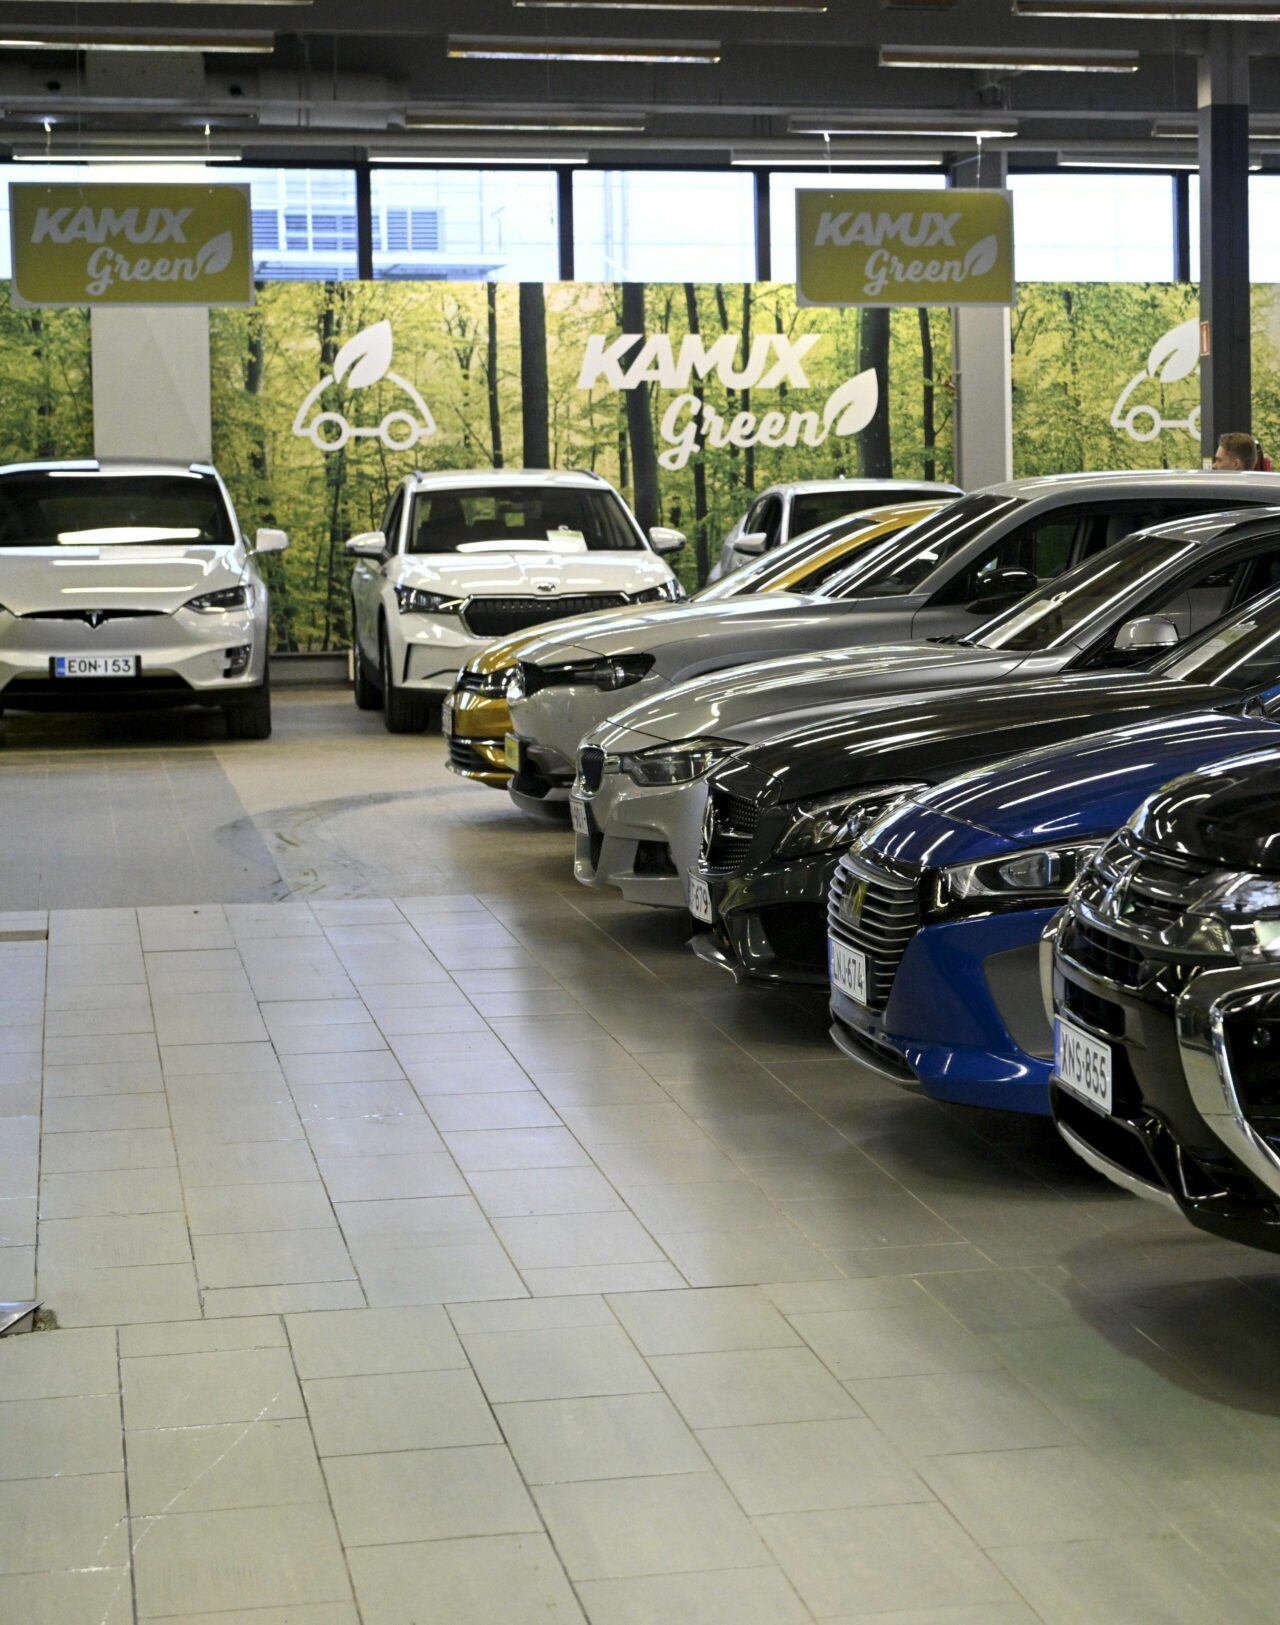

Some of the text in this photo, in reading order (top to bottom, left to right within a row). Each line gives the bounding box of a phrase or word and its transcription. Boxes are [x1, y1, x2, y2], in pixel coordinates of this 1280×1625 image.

[31, 207, 195, 243] KAMUX
[814, 212, 962, 246] KAMUX
[86, 247, 201, 296] Green
[863, 249, 967, 296] Green
[577, 333, 822, 390] KAMUX
[658, 394, 829, 471] Green
[68, 659, 131, 673] EON-153
[1062, 1031, 1107, 1099] XNS-855
